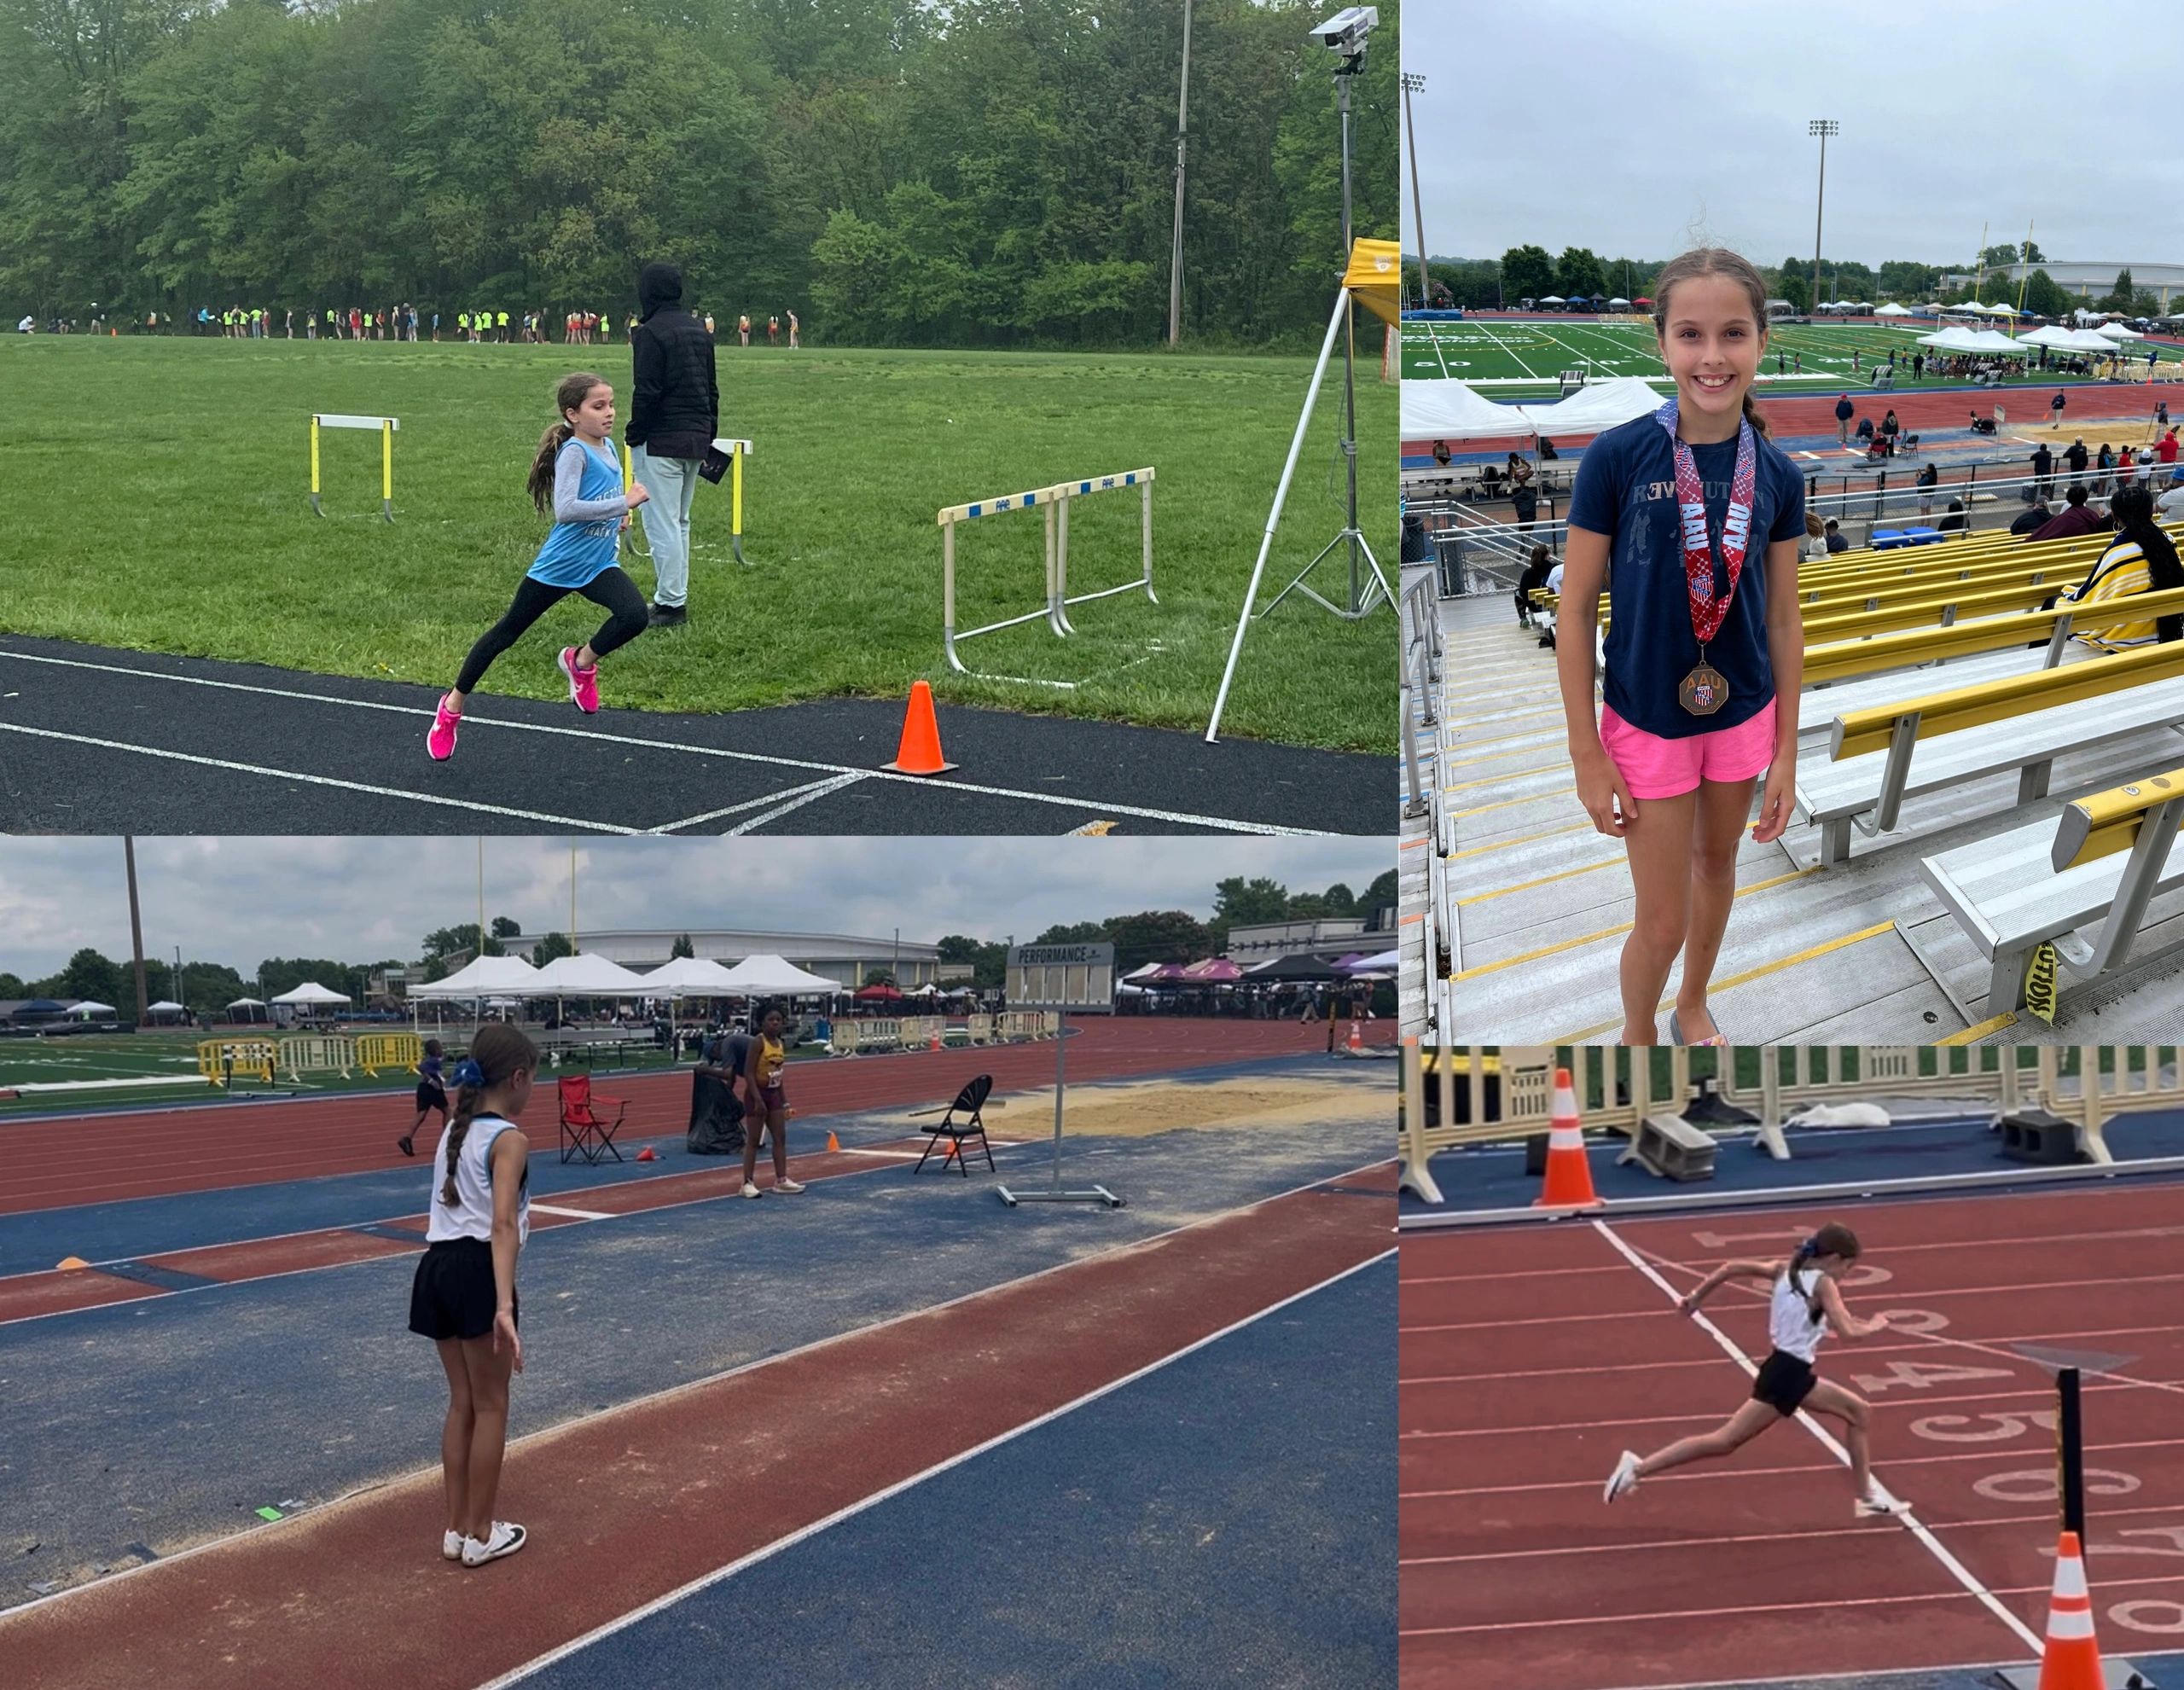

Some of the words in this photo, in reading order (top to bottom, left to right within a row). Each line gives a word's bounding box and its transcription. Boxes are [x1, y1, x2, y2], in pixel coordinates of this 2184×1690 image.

[1681, 503, 1710, 551] AAU
[1722, 502, 1751, 551] AAU
[1685, 673, 1722, 694] AAU
[1019, 947, 1087, 963] PERFORMANCE
[1850, 1362, 2016, 1393] 4
[1909, 1410, 2059, 1443] 5
[1972, 1468, 2141, 1501] 6
